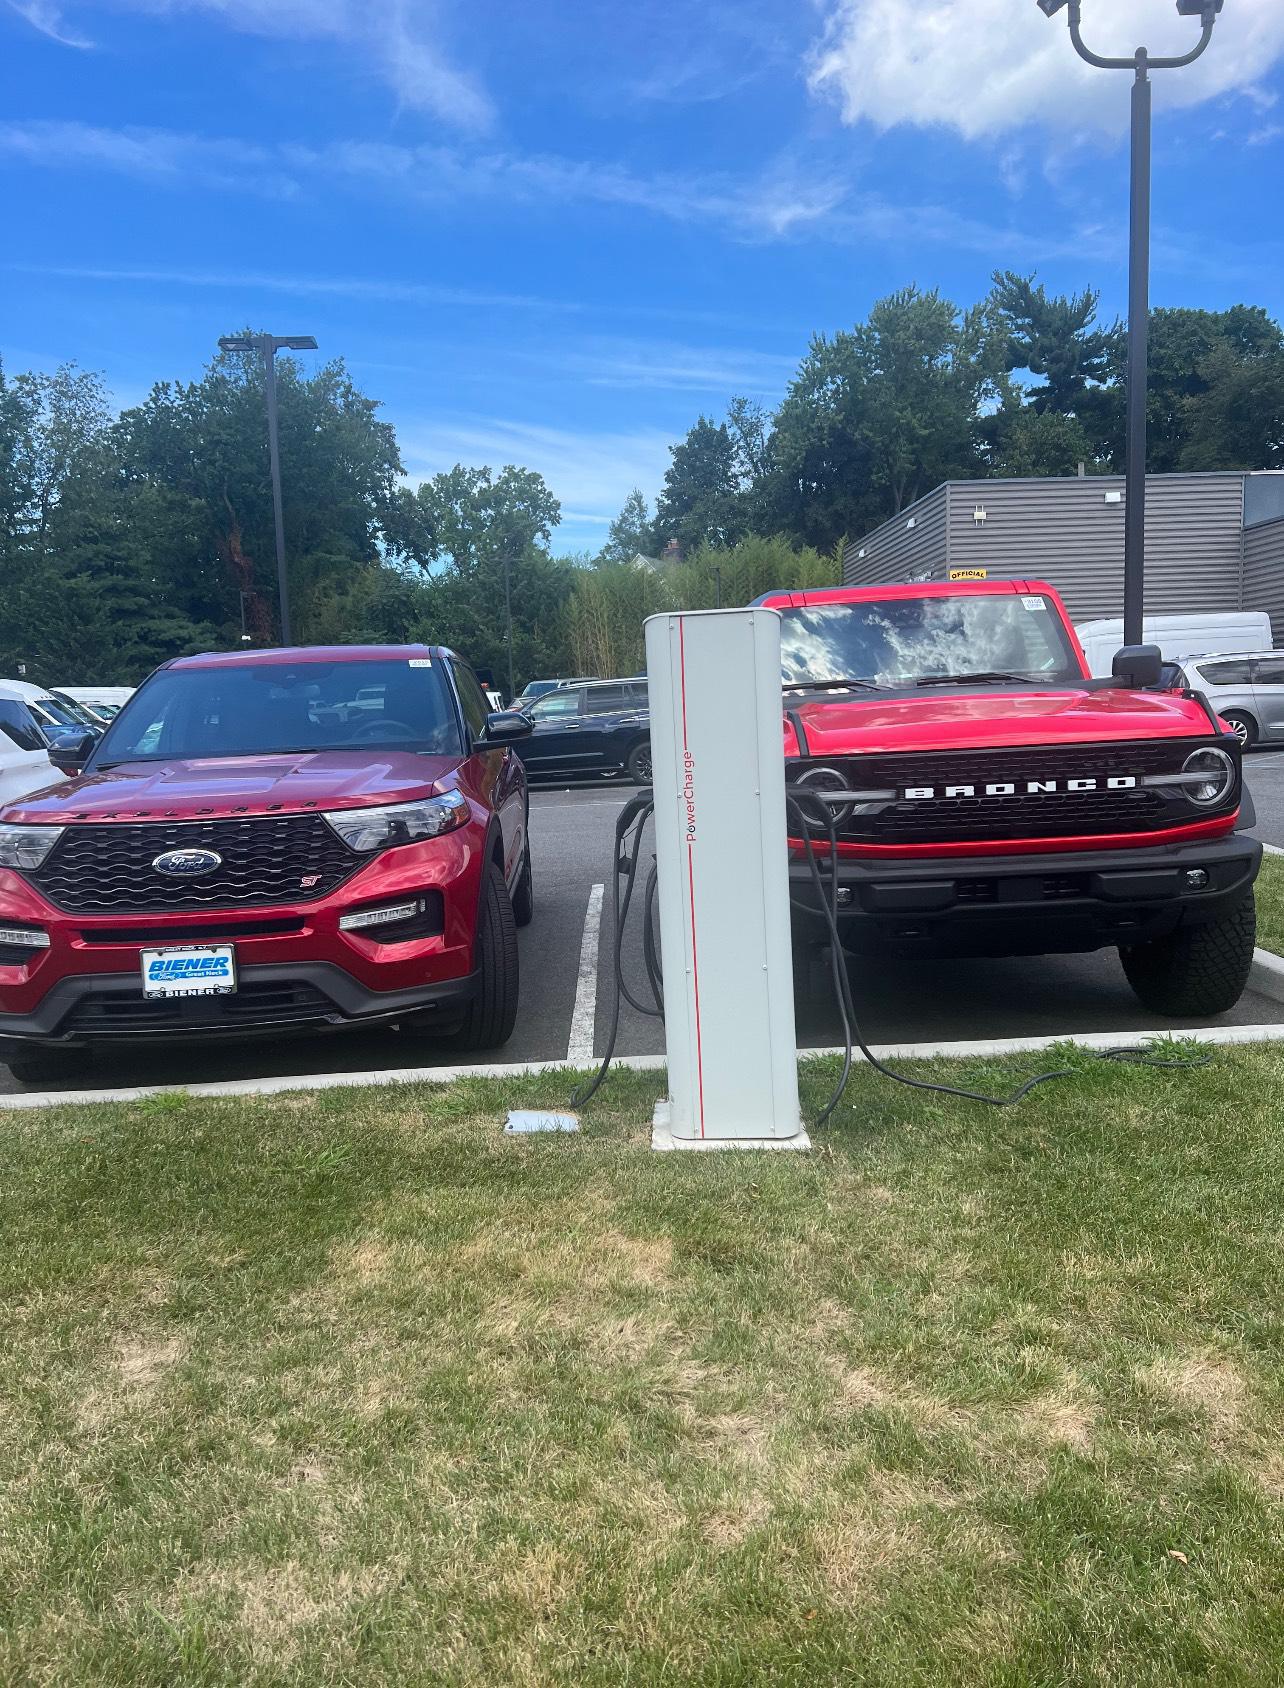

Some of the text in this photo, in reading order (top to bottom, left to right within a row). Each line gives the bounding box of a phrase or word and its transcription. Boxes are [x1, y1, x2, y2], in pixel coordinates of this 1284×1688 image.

[951, 570, 985, 579] OFFICIAL
[904, 776, 1136, 799] BRONCO
[683, 751, 697, 842] PowerCharge
[72, 800, 318, 820] EXPLORER
[169, 853, 205, 870] Ford
[299, 874, 322, 888] ST
[148, 956, 229, 972] BIENER
[165, 988, 215, 998] BIENER
